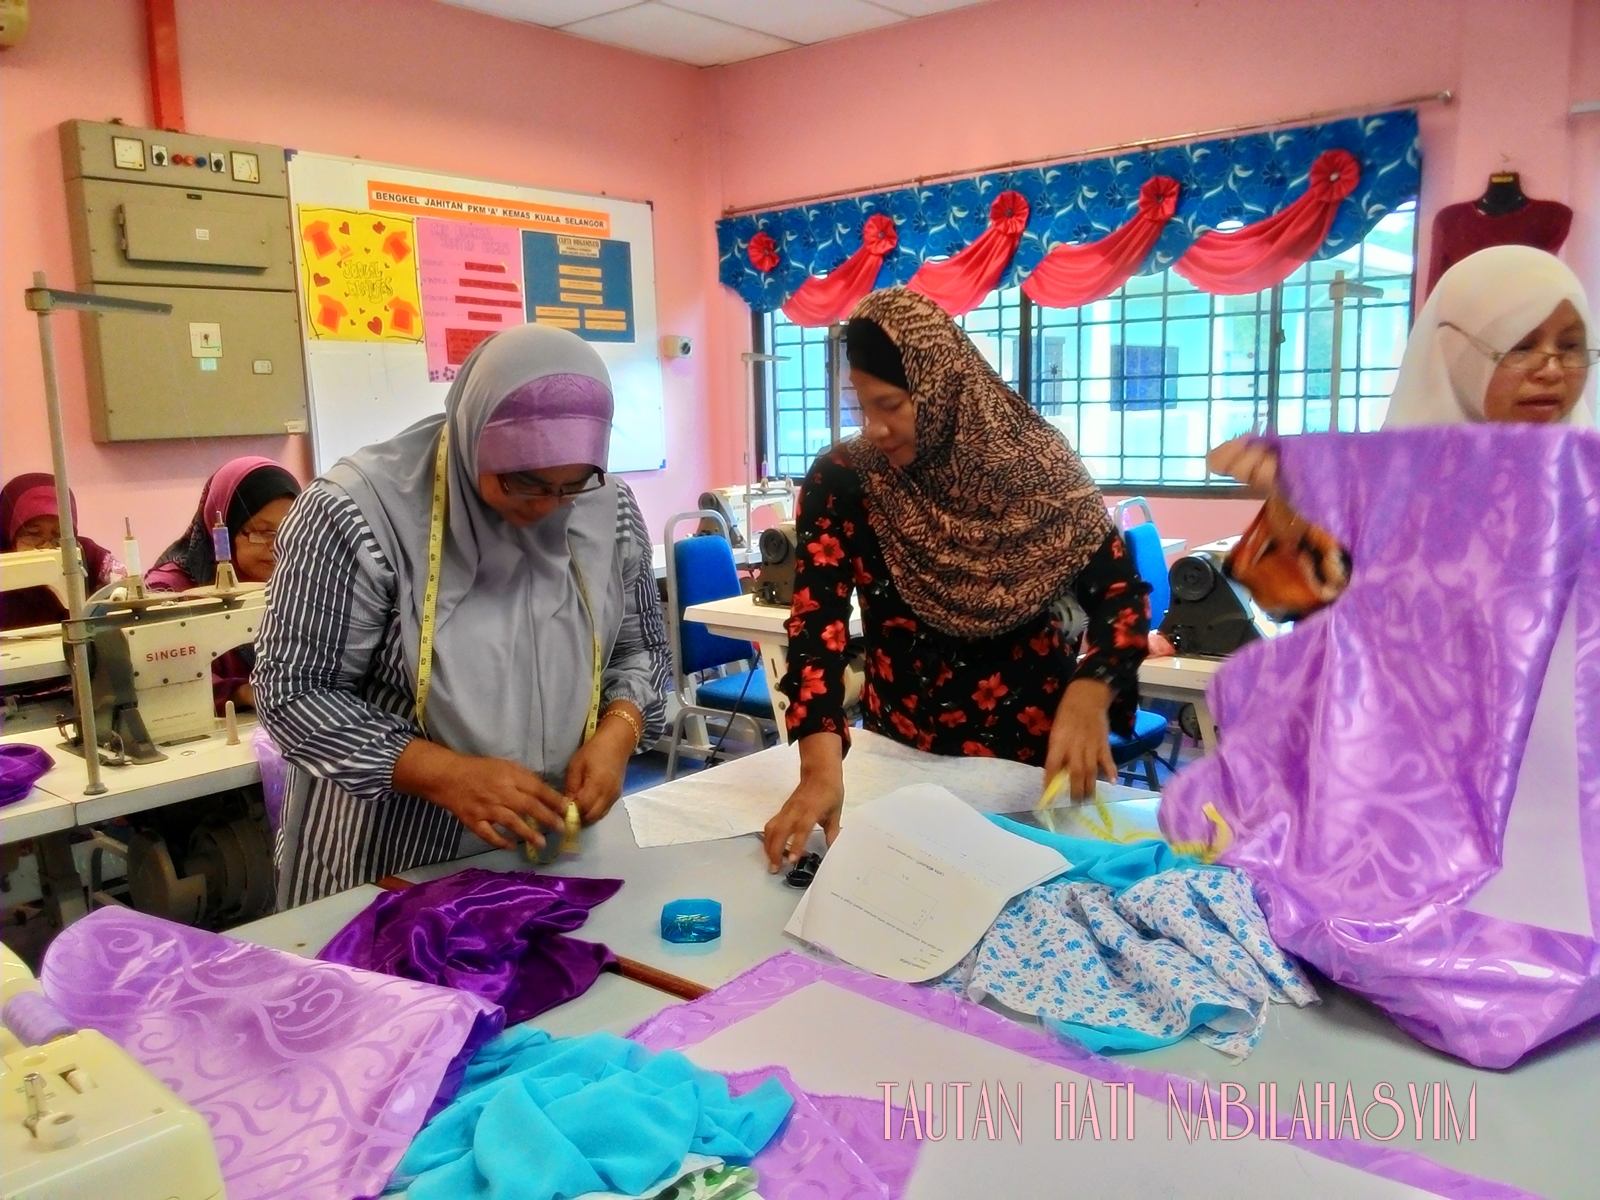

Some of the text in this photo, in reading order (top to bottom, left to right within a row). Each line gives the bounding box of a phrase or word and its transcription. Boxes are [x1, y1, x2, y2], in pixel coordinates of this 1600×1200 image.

[375, 191, 420, 205] BENGKEL
[424, 198, 463, 210] JAHITAN
[502, 209, 531, 220] KEMAS
[534, 213, 561, 223] KUALA
[565, 217, 604, 228] SELANGOR
[145, 645, 197, 662] SINGER
